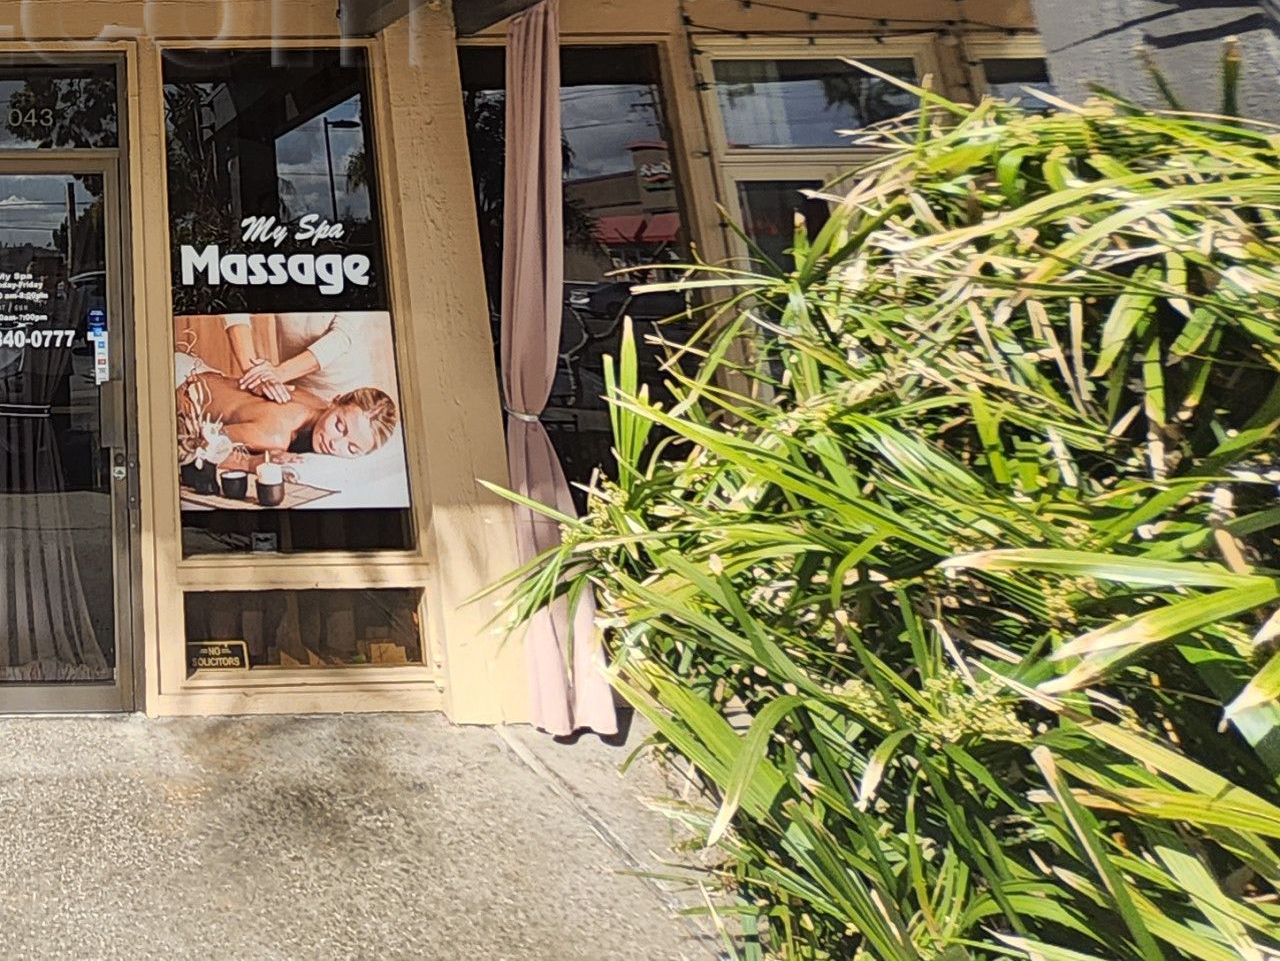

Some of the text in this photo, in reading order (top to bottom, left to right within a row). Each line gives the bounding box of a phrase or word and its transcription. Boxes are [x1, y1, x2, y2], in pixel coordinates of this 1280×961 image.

[241, 213, 345, 248] My Spa
[180, 244, 371, 296] Massage
[13, 272, 33, 282] Spa
[208, 646, 221, 656] NO
[192, 656, 241, 667] SOLICITORS
